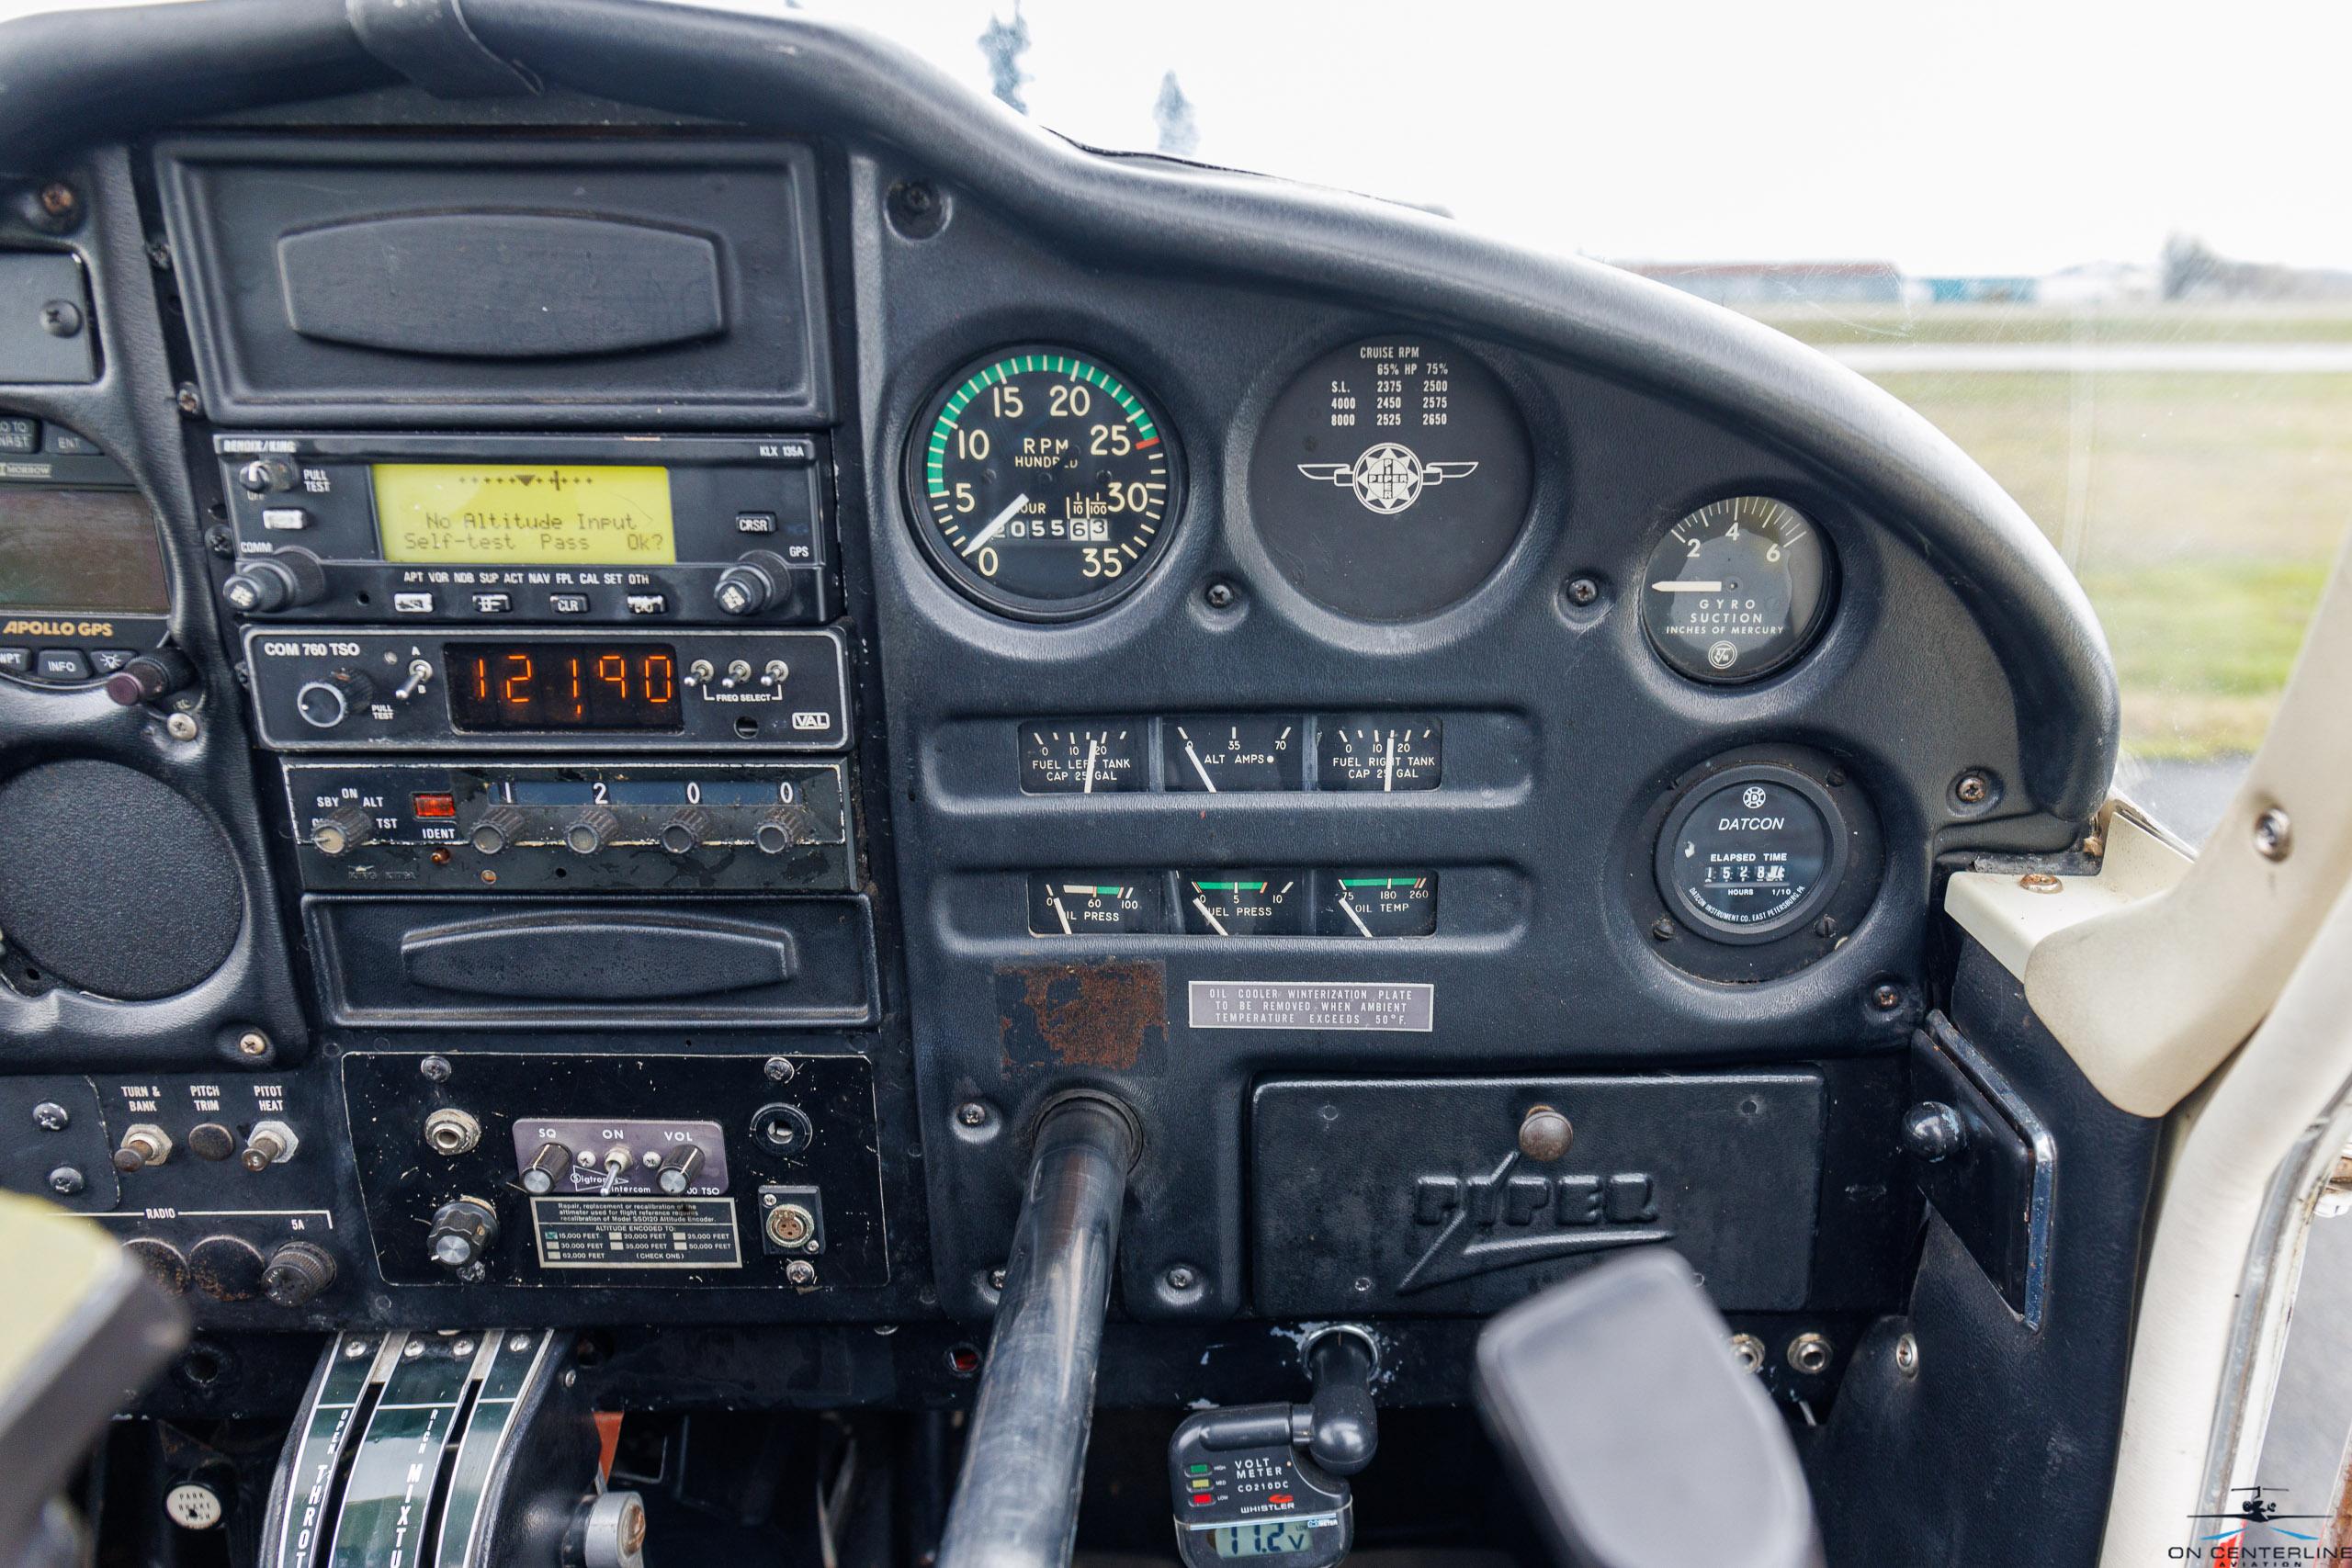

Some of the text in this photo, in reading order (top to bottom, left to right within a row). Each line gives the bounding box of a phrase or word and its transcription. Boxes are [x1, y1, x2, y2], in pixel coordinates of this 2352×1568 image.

[1361, 347, 1419, 359] CRUISE RPM
[1377, 363, 1449, 375] 65% HP 75%
[1331, 380, 1448, 393] S.L. 2375 2500
[994, 387, 1023, 418] 15
[1049, 385, 1091, 417] 20
[1331, 397, 1447, 410] 4000 2450 2575
[1331, 413, 1447, 426] 8000 2525 2650
[58, 437, 80, 448] ENT
[958, 429, 989, 459] 10
[1091, 424, 1130, 456] 25
[760, 446, 778, 457] KLX
[303, 469, 328, 480] PULL
[304, 481, 330, 492] TEST
[956, 483, 975, 513] 5
[1108, 482, 1148, 513] 30
[426, 513, 638, 531] No Altitude Input
[739, 519, 768, 531] CRSR
[1725, 522, 1740, 541] 4
[241, 541, 273, 553] COMM
[404, 532, 664, 551] Self-test Pass Ok?
[789, 546, 809, 557] GPS
[1687, 538, 1701, 558] 2
[1766, 543, 1781, 562] 6
[978, 547, 999, 576] 0
[1082, 548, 1122, 578] 35
[404, 571, 650, 585] APT VOR NDB SUP ACT NAV FPL CAL SET OTH
[557, 599, 579, 612] CLR
[1700, 599, 1756, 610] GYRO
[1690, 613, 1763, 624] SUCTION
[3, 621, 114, 637] APOLLO GPS
[1666, 626, 1783, 635] INCHES OF MERCURY
[264, 643, 361, 656] COM 760 TSO
[411, 646, 421, 656] A
[48, 660, 76, 672] INFO
[417, 685, 426, 694] B
[717, 694, 771, 703] FREQ SELECT
[371, 704, 393, 712] PULL
[373, 712, 394, 720] TEST
[796, 715, 827, 728] VAL
[1094, 745, 1107, 756] 20
[1227, 740, 1240, 750] 35
[1275, 740, 1286, 750] 70
[1346, 744, 1352, 753] 0
[1373, 744, 1383, 753] 10
[1397, 743, 1410, 753] 20
[1041, 747, 1048, 756] 0
[1069, 746, 1080, 756] 10
[1033, 759, 1131, 770] FUEL TANK
[1204, 754, 1264, 764] ALT AMPS
[1333, 756, 1435, 767] FUEL TANK
[1046, 772, 1117, 781] CAP GAL
[1349, 768, 1419, 779] CAP GAL
[342, 788, 358, 800] ON
[593, 782, 608, 805] 2
[686, 782, 701, 805] 0
[780, 781, 794, 804] 0
[317, 796, 339, 807] SBY
[363, 796, 383, 807] ALT
[376, 818, 397, 829] TST
[1718, 818, 1784, 830] DATCON
[423, 828, 456, 840] IDENT
[1710, 852, 1788, 863] ELAPSED TIME
[1342, 891, 1354, 901] 75
[1380, 891, 1396, 899] 180
[1409, 890, 1429, 899] 260
[1771, 888, 1791, 897] 1/10
[1046, 897, 1053, 907] 0
[1088, 898, 1102, 908] 60
[1121, 899, 1138, 909] 100
[1233, 895, 1239, 904] 5
[1272, 894, 1283, 904] 10
[1689, 886, 1706, 908] DATCON
[1705, 903, 1739, 922] INSTRUMENT
[1752, 911, 1768, 921] EAST
[1237, 907, 1272, 917] PRESS
[1355, 903, 1409, 913] OIL TEMP
[1084, 911, 1119, 921] PRESS
[1209, 988, 1412, 1000] OIL COOLER WINTERIZATION PLATE
[1216, 1000, 1407, 1012] TO BE REMOVED WHEN AMBIENT
[1216, 1012, 1295, 1022] TEMPERATURE
[1309, 1014, 1360, 1024] EXCEEDS
[121, 1086, 160, 1097] TURN &
[190, 1086, 220, 1097] PITCH
[254, 1086, 282, 1097] PITOT
[130, 1101, 156, 1111] BANK
[194, 1100, 220, 1111] TRIM
[259, 1100, 283, 1111] HEAT
[538, 1128, 557, 1140] SQ
[602, 1129, 624, 1140] ON
[663, 1131, 693, 1142] VOL
[702, 1186, 720, 1196] TSO
[1415, 1172, 1657, 1226] PIPER
[146, 1208, 175, 1219] RADIO
[291, 1219, 304, 1230] 5A
[327, 1409, 349, 1455] OPEN
[418, 1408, 439, 1454] RICH
[1235, 1458, 1270, 1470] VOLT
[1237, 1467, 1283, 1479] METER
[1240, 1502, 1295, 1514] WHISTLER
[1288, 1534, 1306, 1551] V
